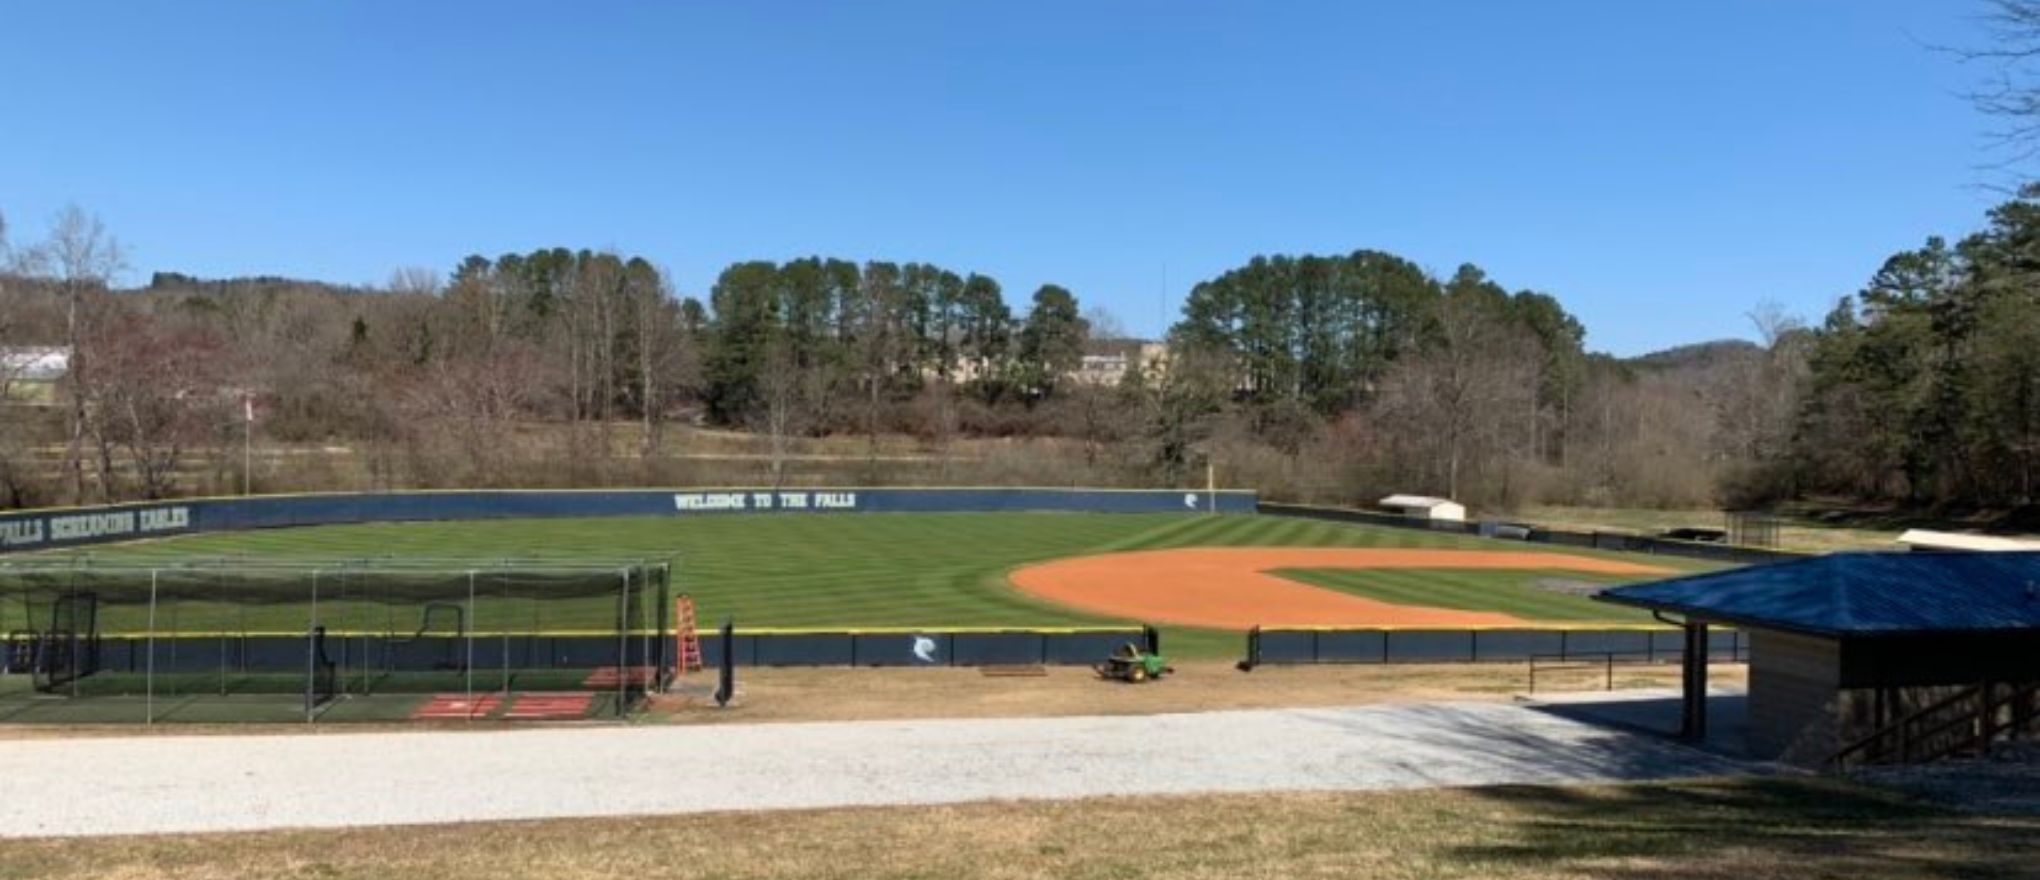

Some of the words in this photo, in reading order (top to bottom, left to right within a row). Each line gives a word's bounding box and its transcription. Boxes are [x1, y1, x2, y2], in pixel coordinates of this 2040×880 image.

[674, 493, 745, 509] WELCOME
[753, 493, 772, 507] TO
[778, 493, 808, 507] THE
[814, 493, 855, 507] FALLS
[51, 511, 134, 539] SCREAMING
[140, 507, 188, 531] EAGLES
